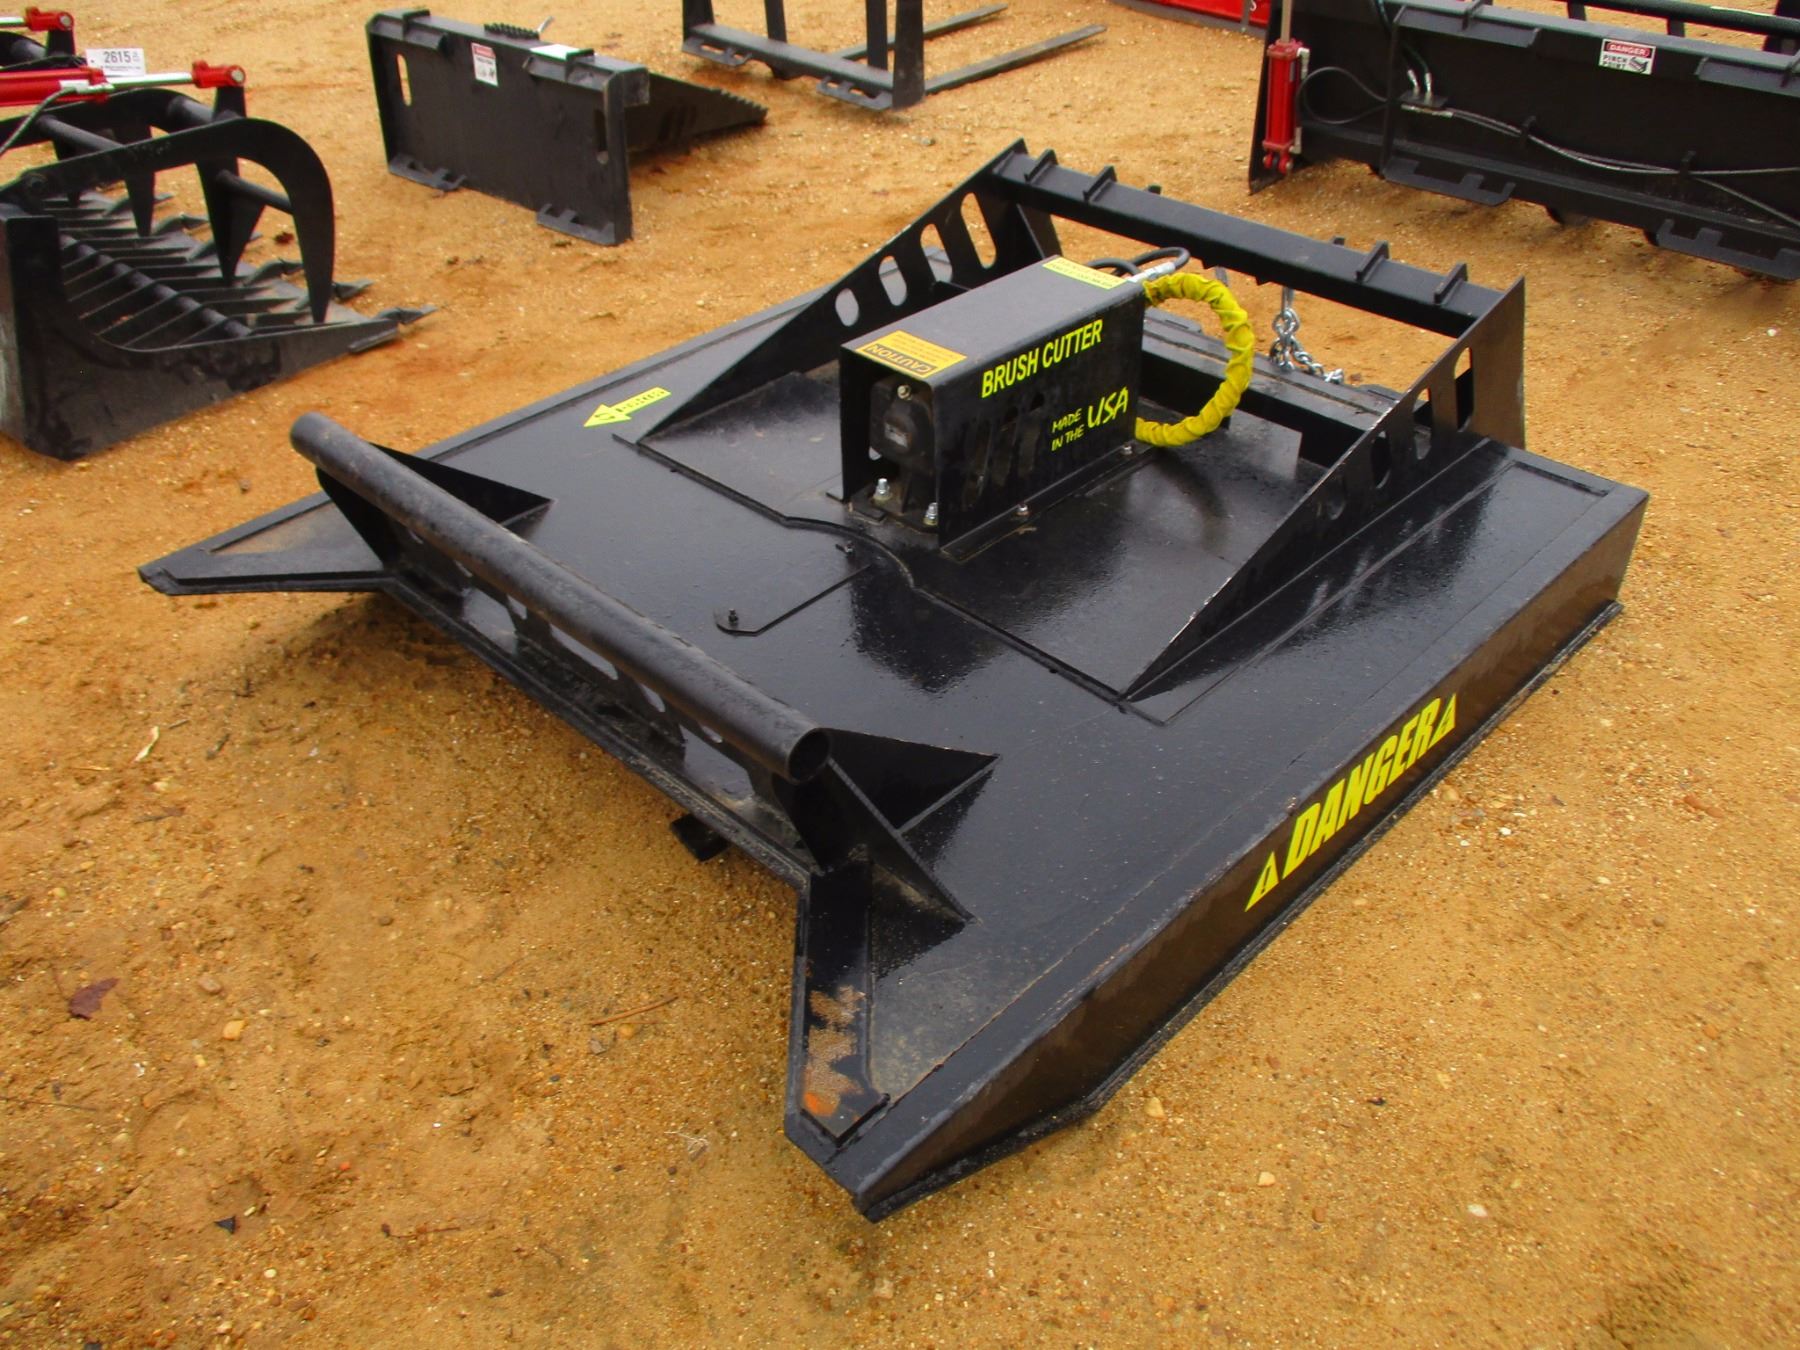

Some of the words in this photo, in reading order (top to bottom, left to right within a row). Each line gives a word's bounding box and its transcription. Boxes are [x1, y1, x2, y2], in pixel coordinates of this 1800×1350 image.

[103, 50, 131, 64] 2615
[1609, 44, 1646, 56] DANGER
[868, 344, 932, 373] CAUTION
[981, 348, 1039, 399] BRUSH
[1042, 319, 1104, 368] CUTTER
[1051, 408, 1082, 433] MADE
[1087, 386, 1129, 429] USA
[1051, 436, 1063, 451] IN
[1065, 424, 1085, 443] THE
[1282, 697, 1441, 880] DANGER
